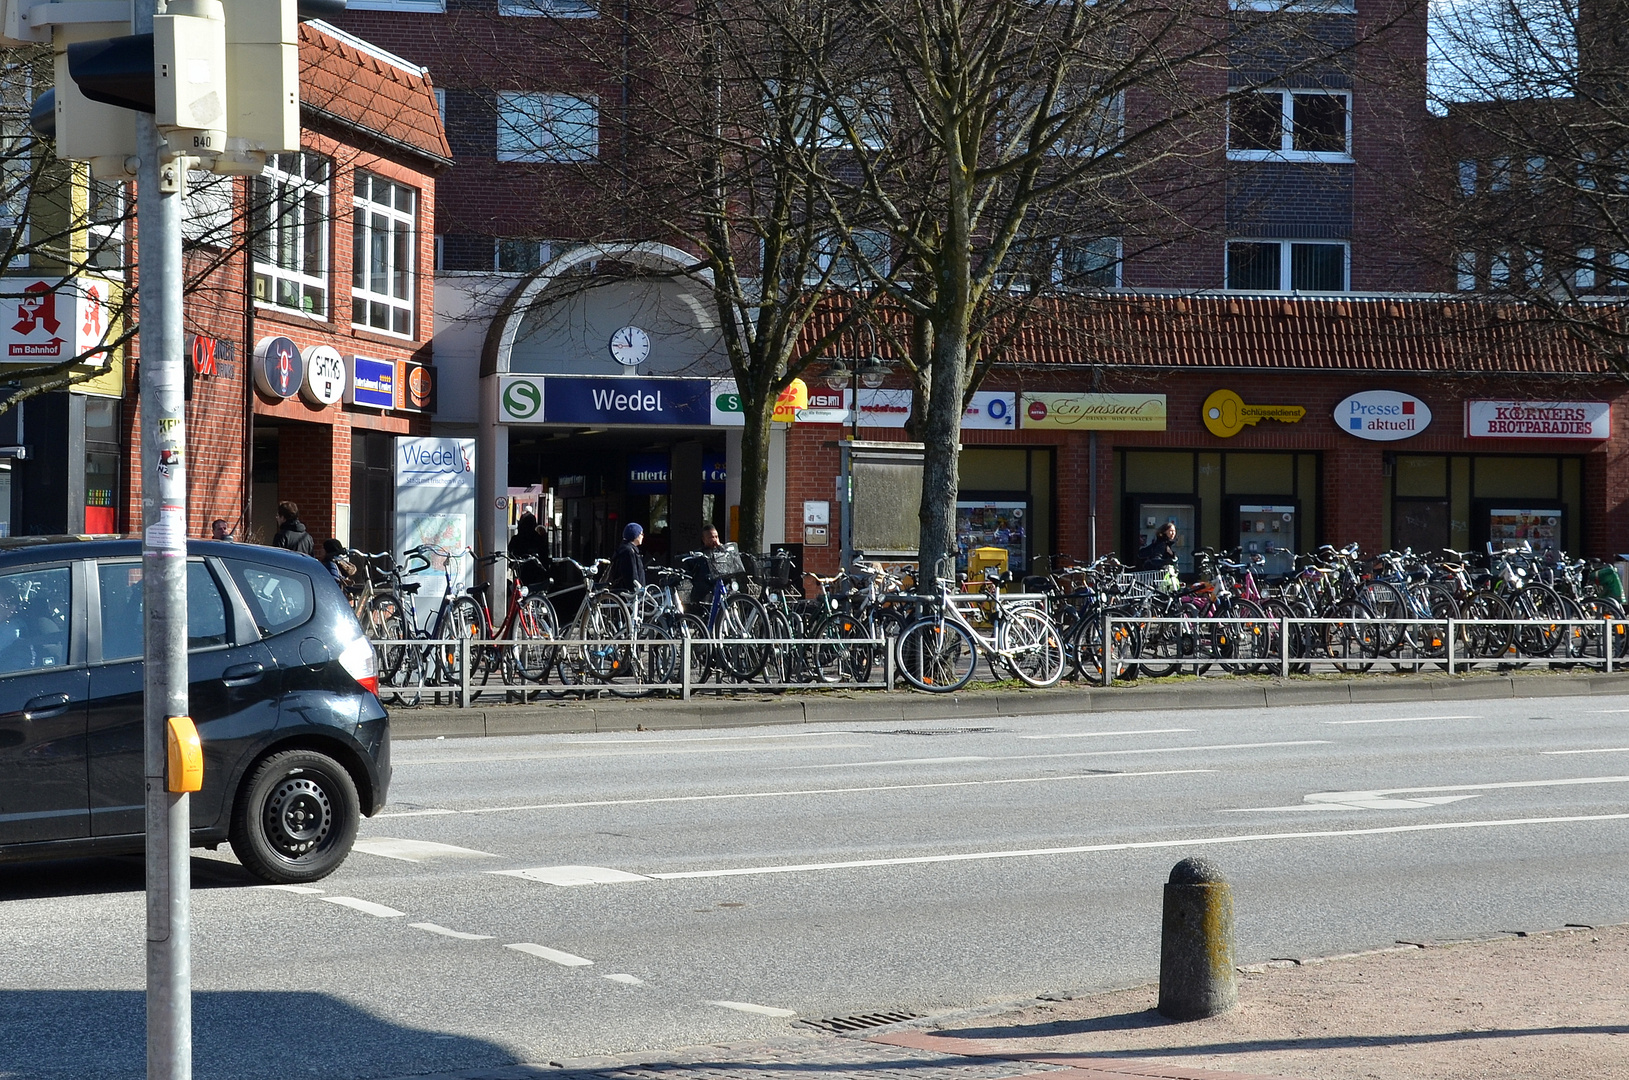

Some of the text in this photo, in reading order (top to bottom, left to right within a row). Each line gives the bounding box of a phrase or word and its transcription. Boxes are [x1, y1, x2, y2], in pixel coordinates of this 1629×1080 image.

[193, 136, 212, 148] B40
[12, 345, 58, 354] im Bahnhof
[509, 384, 535, 416] S
[592, 389, 663, 412] Wedel
[773, 405, 802, 415] OTT
[860, 404, 908, 413] vodafone
[1066, 400, 1162, 424] passant
[1241, 408, 1302, 416] Schlüsseldienst
[1350, 401, 1400, 415] Presse
[1367, 418, 1415, 430] aktuell
[1487, 421, 1593, 434] BROTPARADIES
[402, 444, 457, 466] Wedel
